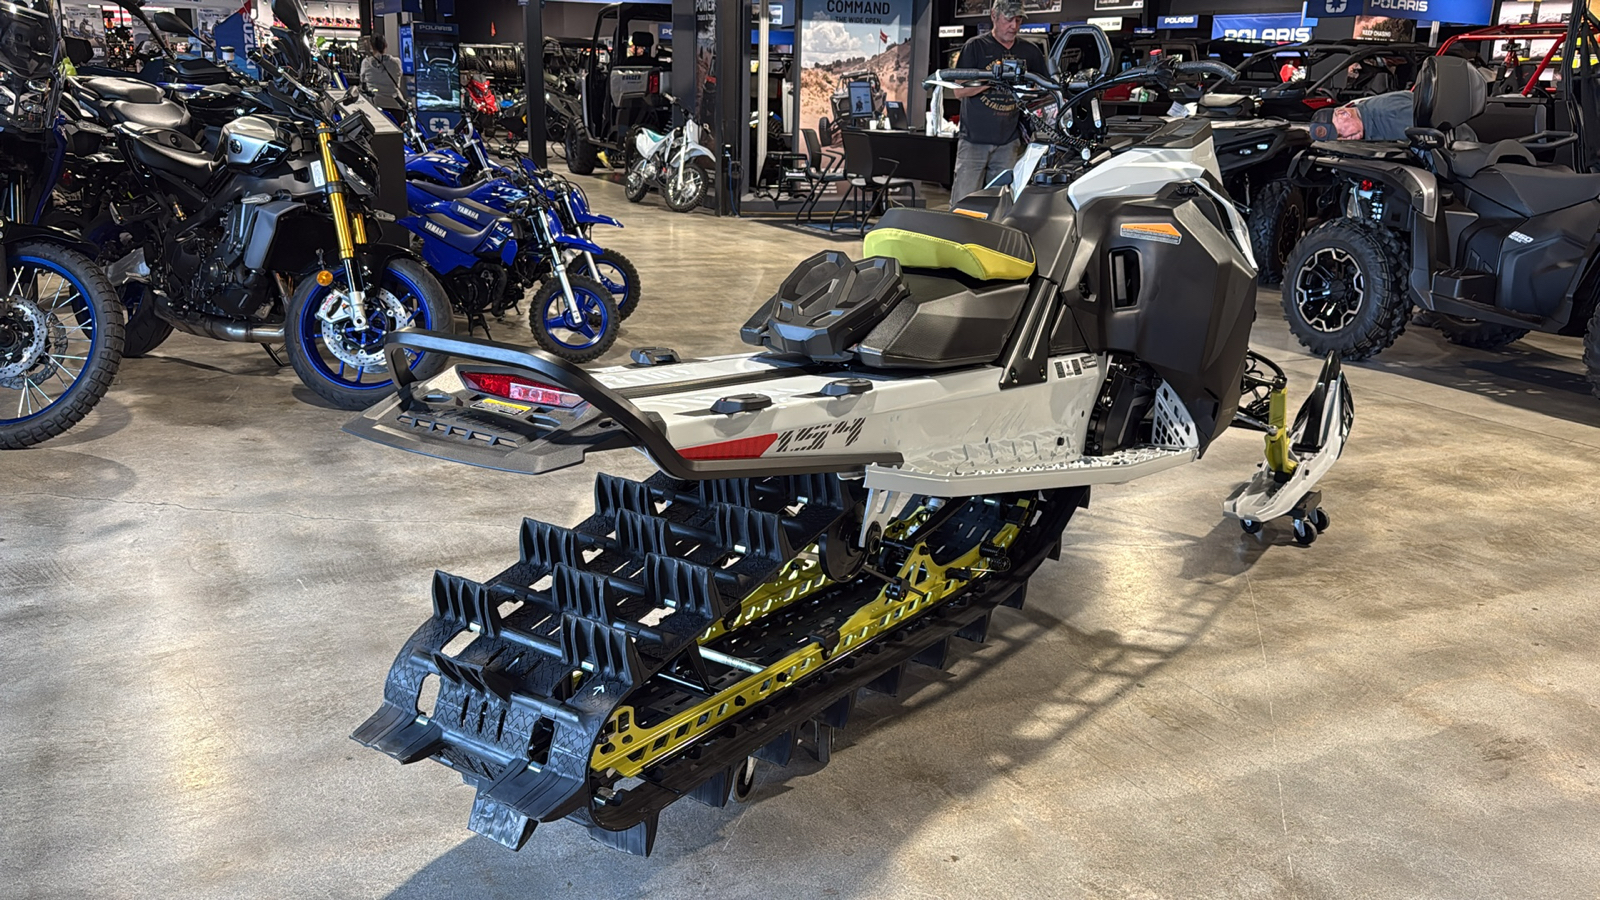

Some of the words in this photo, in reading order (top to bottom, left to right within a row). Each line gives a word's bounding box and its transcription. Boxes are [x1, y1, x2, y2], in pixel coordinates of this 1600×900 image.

[827, 0, 890, 15] COMMAND
[1371, 0, 1429, 12] POLARIS
[419, 24, 453, 32] POLARIS
[1223, 28, 1310, 43] POLARIS
[456, 205, 480, 220] YAMAHA
[424, 221, 447, 239] YAMAHA
[776, 416, 867, 453] 154
